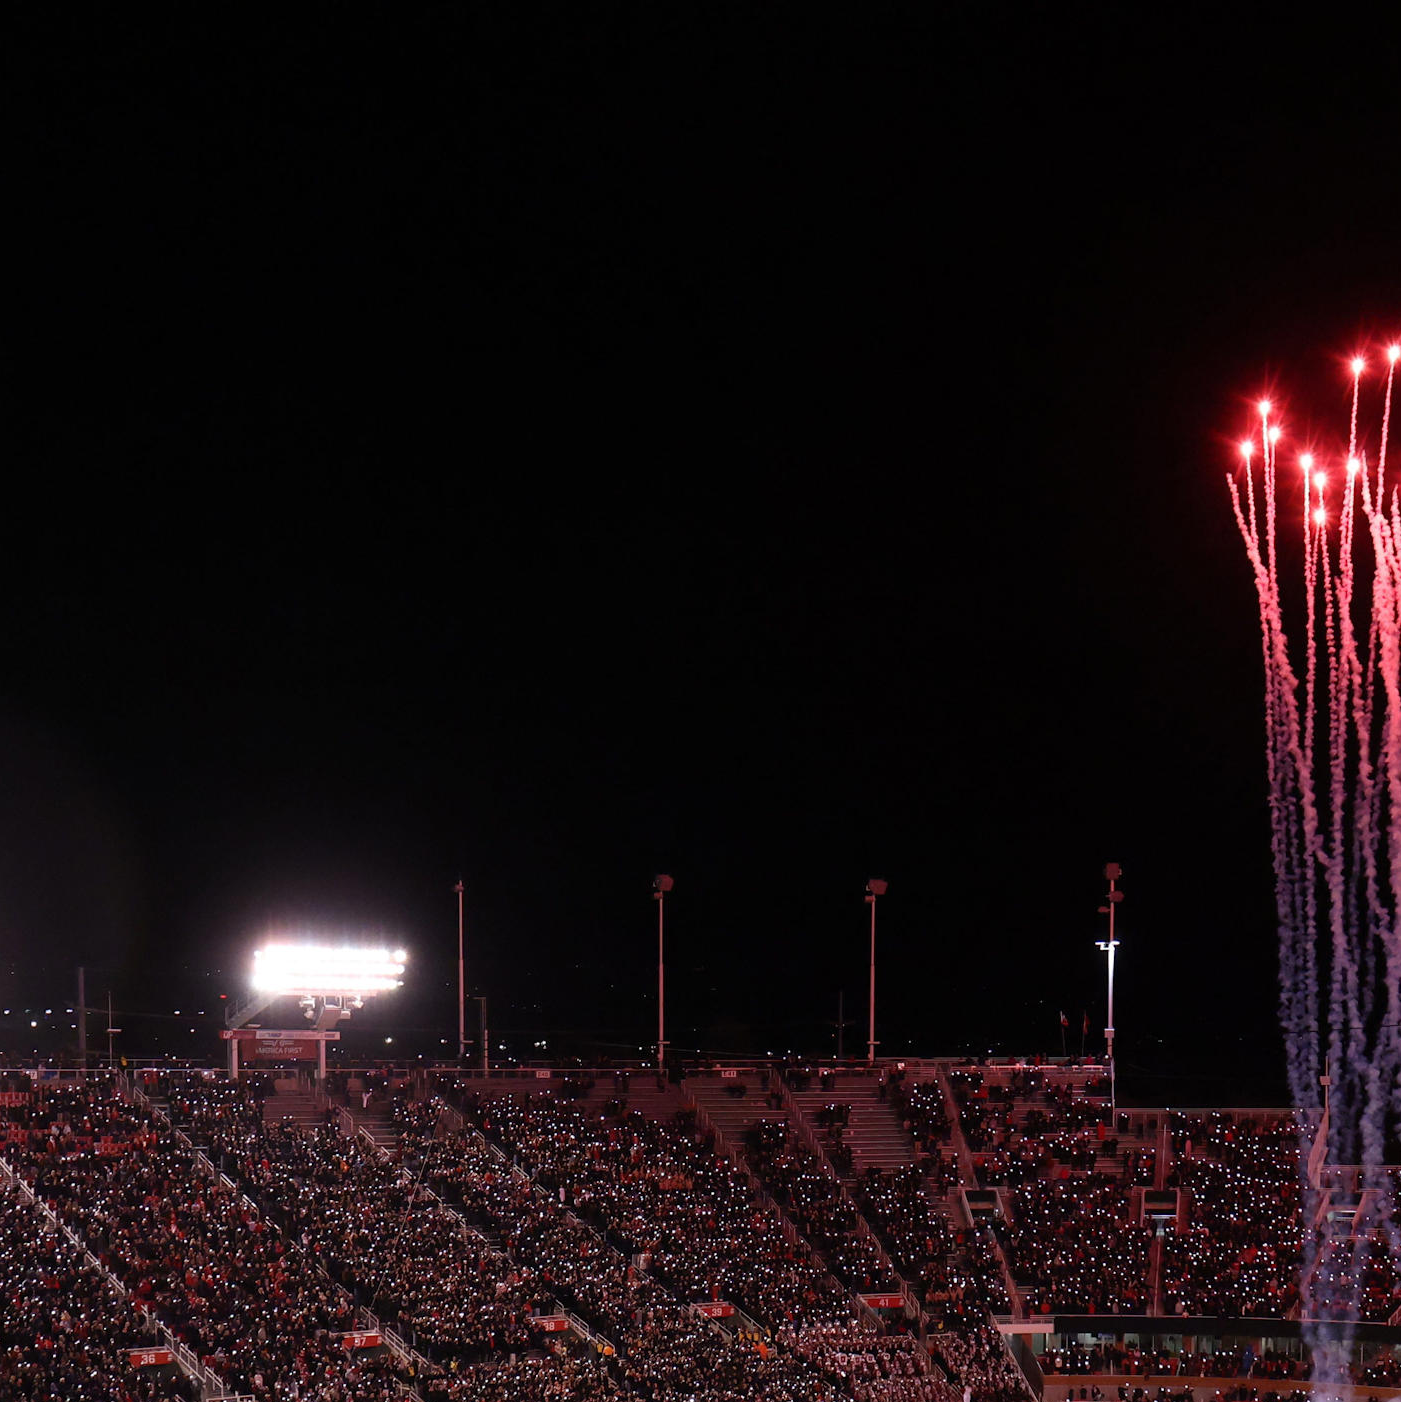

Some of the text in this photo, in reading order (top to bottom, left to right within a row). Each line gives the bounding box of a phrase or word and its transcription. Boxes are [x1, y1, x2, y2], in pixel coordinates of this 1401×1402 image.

[878, 1298, 889, 1307] 41
[711, 1308, 722, 1316] 39
[141, 1354, 155, 1364] 36
